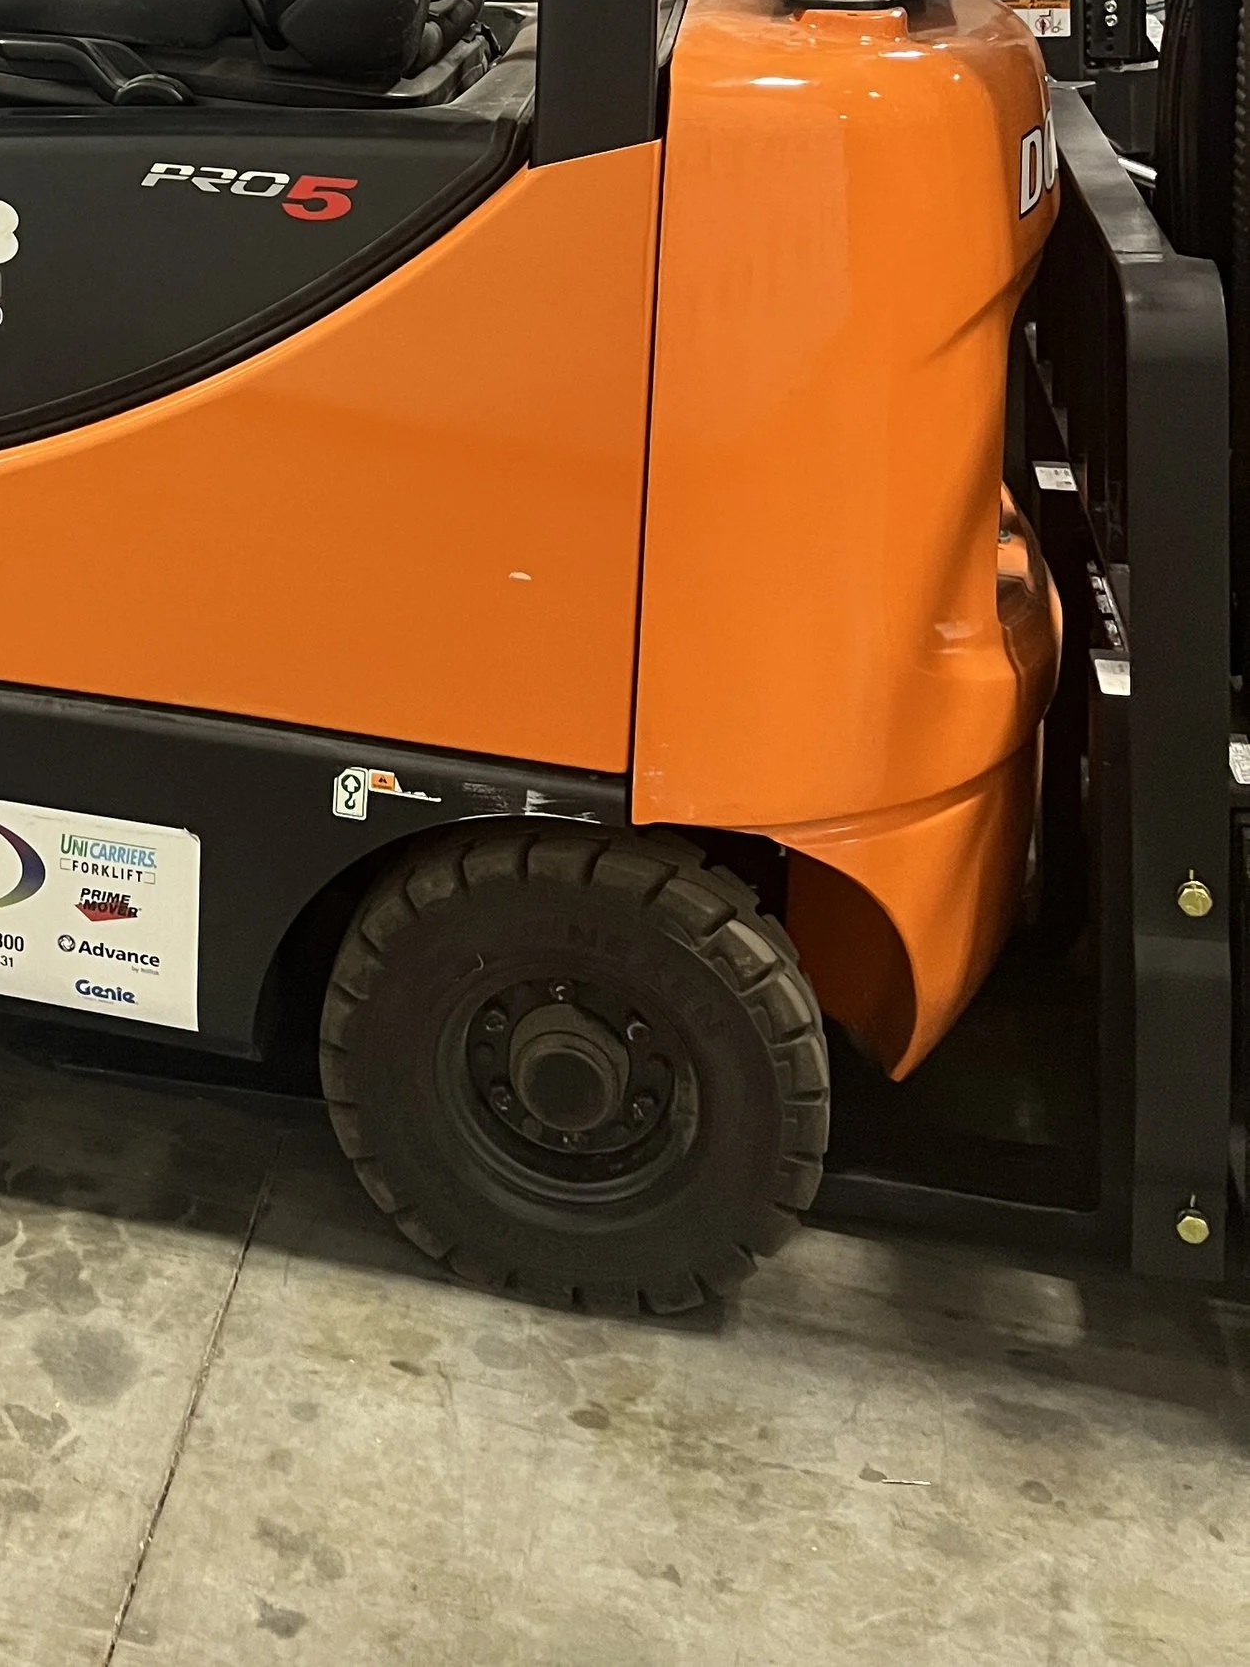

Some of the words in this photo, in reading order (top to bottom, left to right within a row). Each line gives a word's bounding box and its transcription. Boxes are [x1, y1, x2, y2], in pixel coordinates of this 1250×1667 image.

[141, 161, 359, 221] PRO5
[61, 833, 157, 868] UNICARRIERS
[71, 860, 143, 883] FORKLIFT
[80, 887, 131, 905] PRIME
[81, 899, 138, 918] MOVER
[78, 940, 160, 967] Advance
[75, 979, 135, 1004] Genie
